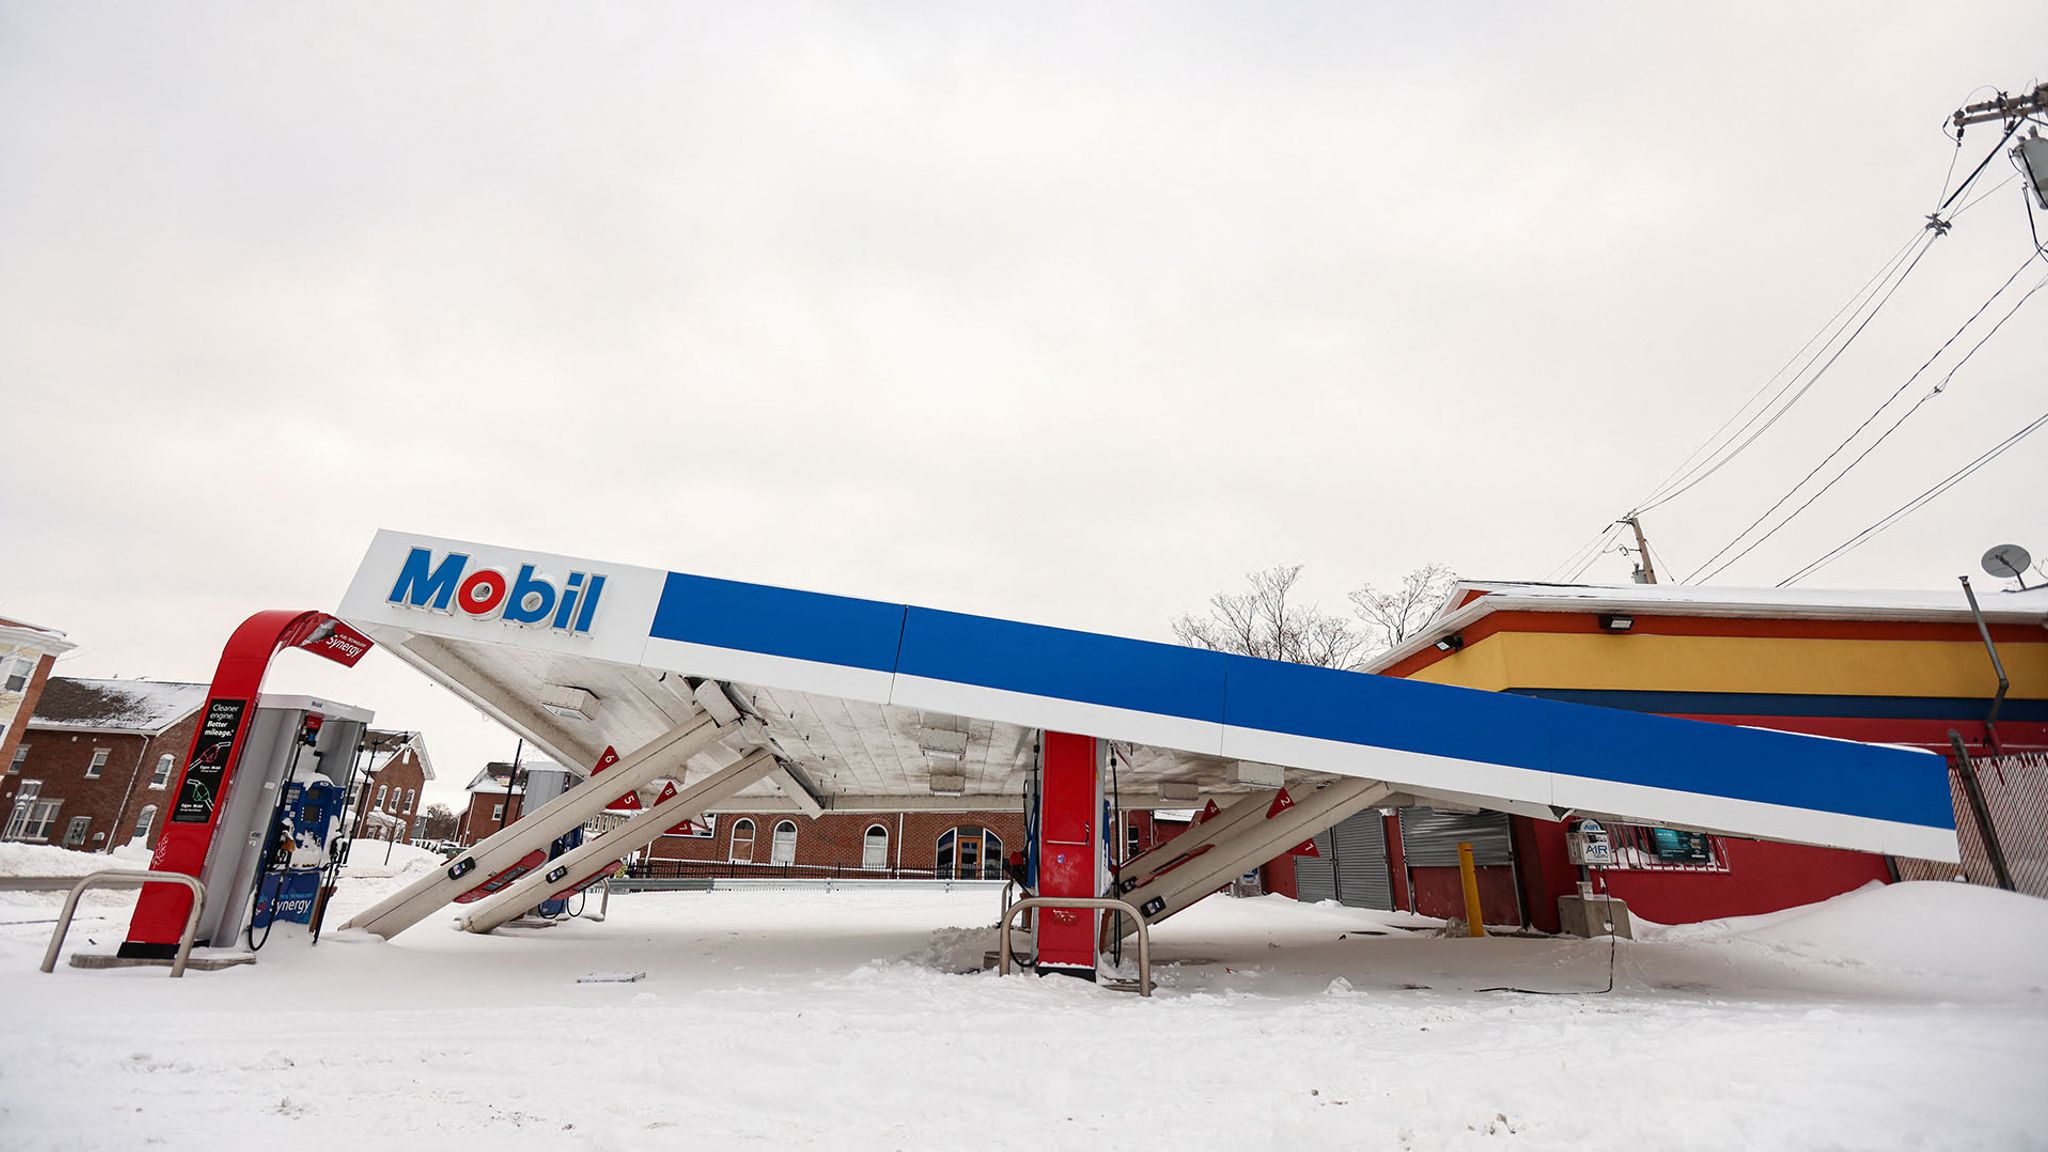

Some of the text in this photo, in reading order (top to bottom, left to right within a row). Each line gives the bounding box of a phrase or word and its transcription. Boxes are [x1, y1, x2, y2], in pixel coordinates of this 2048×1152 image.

[386, 547, 608, 634] Mobil
[325, 634, 363, 658] Synergy
[212, 703, 239, 712] Cleaner
[209, 712, 234, 721] engine.
[665, 788, 673, 796] 8
[624, 795, 635, 804] 5
[1280, 797, 1290, 806] 2
[1585, 845, 1608, 854] AIR
